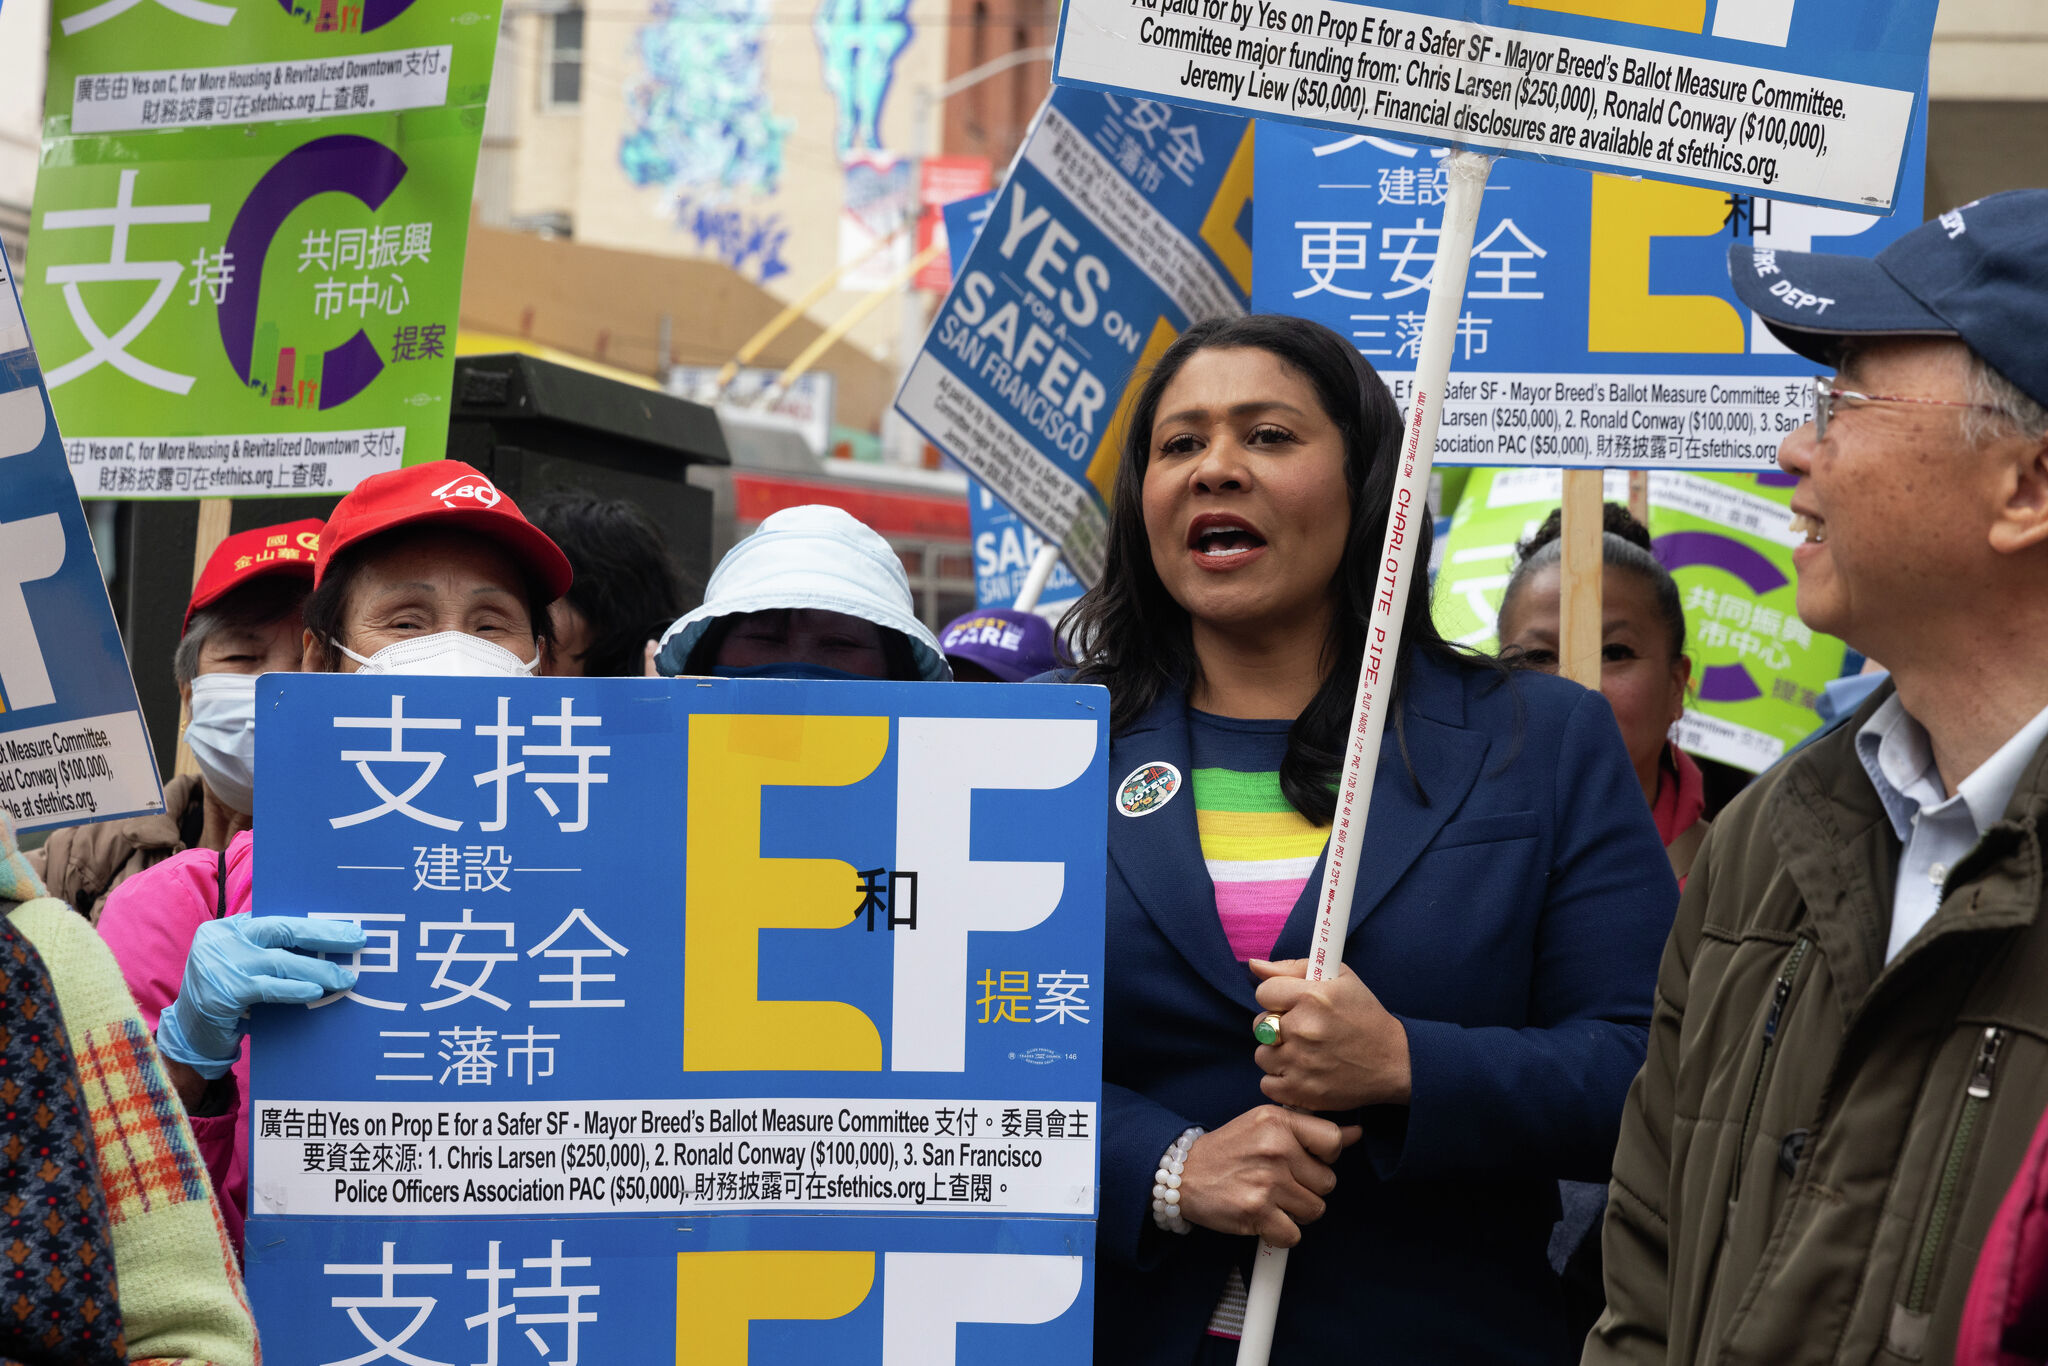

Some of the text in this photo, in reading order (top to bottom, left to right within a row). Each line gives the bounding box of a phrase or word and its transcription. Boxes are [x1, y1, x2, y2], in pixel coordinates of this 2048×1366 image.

[132, 76, 150, 95] Yes
[152, 80, 166, 93] on
[181, 73, 197, 92] for
[199, 74, 226, 90] More
[228, 68, 272, 90] Housing
[285, 61, 345, 83] Revitalized
[346, 58, 403, 79] Downtown
[1203, 0, 1228, 20] for
[1231, 0, 1253, 31] by
[1258, 0, 1287, 30] Yes
[1292, 12, 1313, 35] on
[1317, 10, 1358, 47] Prop
[1361, 17, 1375, 44] E
[1378, 20, 1403, 48] for
[1405, 30, 1416, 50] a
[1419, 26, 1465, 58] Safer
[1468, 34, 1493, 62] SF
[1504, 40, 1554, 76] Mayor
[1556, 48, 1619, 81] Breed's
[1622, 58, 1672, 91] Ballot
[1675, 66, 1747, 102] Measure
[1752, 79, 1846, 119] Committee.
[1140, 17, 1828, 157] Committee major funding from: Chris Larsen ($250,000), Ronald Conway ($100,000),
[1181, 60, 1779, 184] Jeremy Liew ($50,000). Financial disclosures are available at sfethics.org.
[297, 222, 432, 273] 共同振興
[999, 182, 1110, 328] YES
[1104, 311, 1141, 353] ON
[1292, 218, 1547, 300] 更安全
[312, 273, 409, 320] 市中心
[1023, 293, 1054, 327] FOR
[1769, 280, 1835, 315] DEPT
[390, 323, 446, 363] 提案
[954, 270, 1107, 435] SAFER
[939, 315, 983, 375] SAN
[980, 350, 1089, 461] FRANCISCO
[1481, 382, 1498, 399] SF
[1511, 382, 1551, 405] Mayor
[1609, 384, 1648, 403] Ballot
[1651, 384, 1707, 403] Measure
[1710, 385, 1780, 405] Committee
[1442, 408, 1488, 427] Larsen
[1566, 410, 1576, 428] 2.
[1580, 409, 1629, 429] Ronald
[1632, 411, 1685, 434] Conway
[1760, 413, 1771, 431] 3.
[1498, 435, 1527, 454] PAC
[1378, 488, 1411, 616] CHARLOTTE
[944, 626, 1023, 651] CARE
[6, 740, 53, 762] Measure
[52, 728, 111, 754] Committee.
[328, 694, 611, 833] 支持
[1351, 754, 1361, 769] PVC
[15, 768, 59, 789] Conway
[1345, 791, 1354, 805] SCH
[22, 797, 34, 817] at
[412, 843, 512, 893] 建設
[683, 714, 1098, 1073] E F
[854, 867, 918, 932] 和
[305, 907, 630, 1012] 更安全
[976, 968, 1090, 1025] 提案
[375, 1025, 561, 1086] 三藩市
[364, 1116, 388, 1136] on
[392, 1112, 432, 1142] Prop
[438, 1112, 449, 1136] E
[454, 1111, 479, 1136] for
[483, 1117, 493, 1136] a
[498, 1111, 543, 1136] Safer
[547, 1111, 569, 1136] SF
[585, 1110, 637, 1140] Mayor
[641, 1109, 705, 1135] Breed's
[710, 1108, 758, 1134] Ballot
[762, 1108, 833, 1134] Measure
[838, 1107, 929, 1134] Committee
[428, 1141, 1042, 1173] 1. Chris Larsen ($250,000), 2. Ronald Conway ($100,000), 3. San Francisco
[335, 1178, 387, 1202] Police
[392, 1178, 460, 1202] Officers
[463, 1176, 564, 1202] Association
[569, 1176, 605, 1201] PAC
[319, 1239, 600, 1366] 支持
